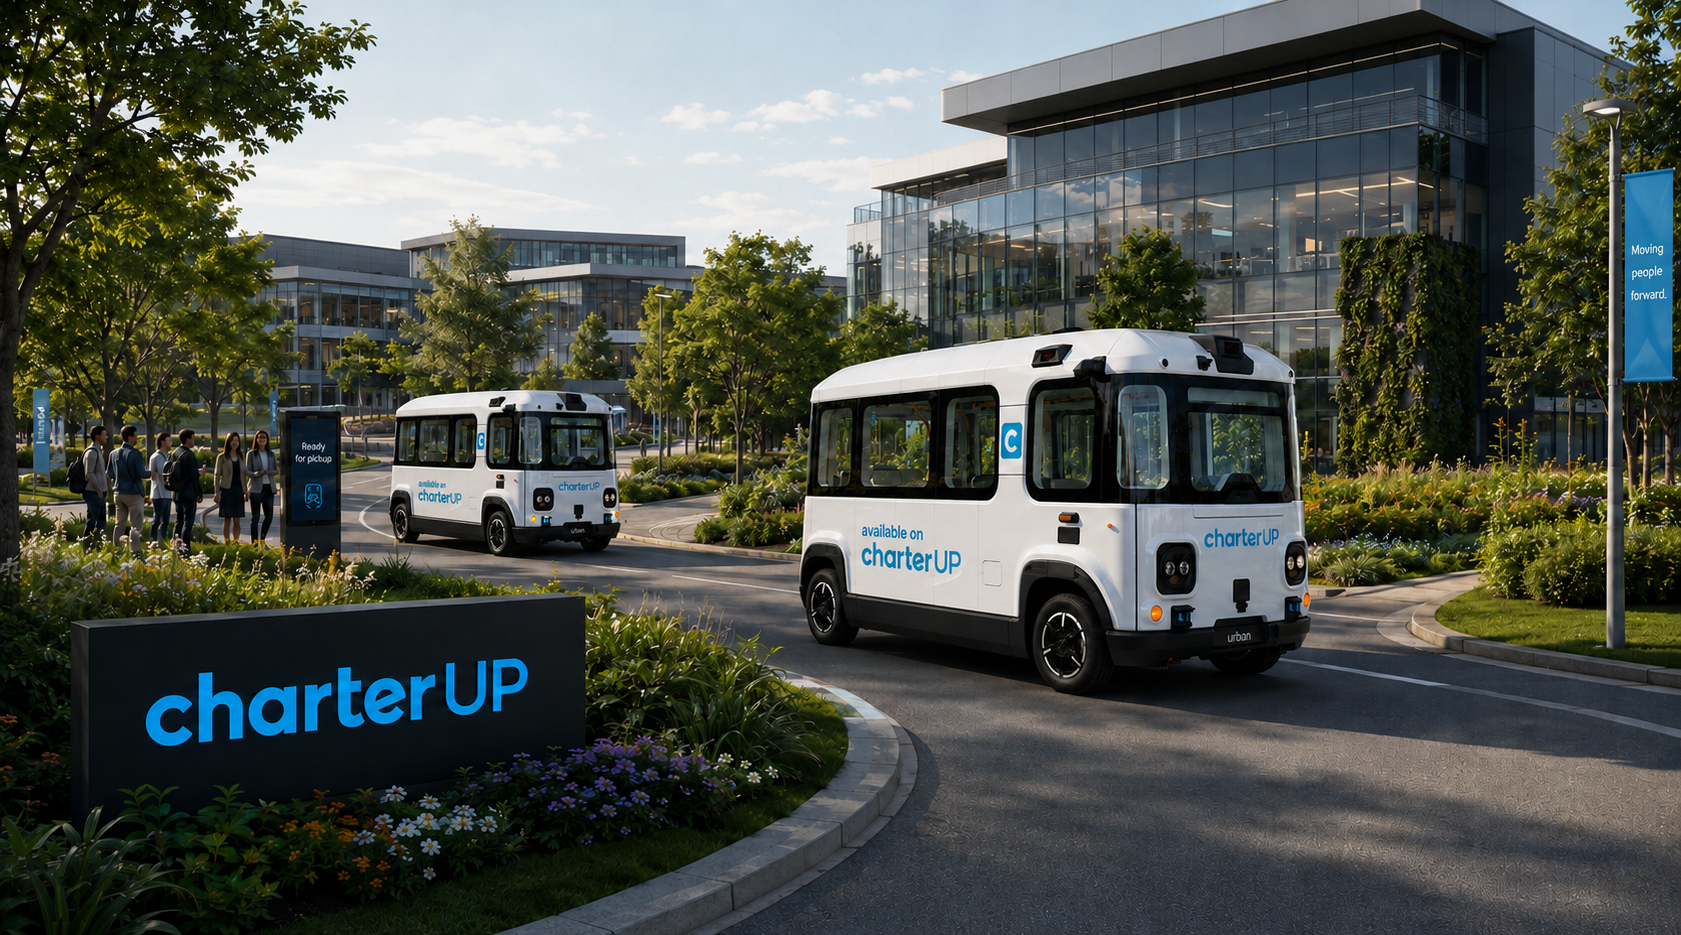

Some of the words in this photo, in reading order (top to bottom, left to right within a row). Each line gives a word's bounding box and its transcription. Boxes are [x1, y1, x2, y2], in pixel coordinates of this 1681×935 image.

[1631, 243, 1664, 256] Moving
[1631, 265, 1663, 280] people
[1630, 288, 1667, 301] forward.
[301, 441, 326, 453] Ready
[295, 454, 305, 464] for
[558, 481, 601, 492] charterUP
[417, 489, 463, 505] charterUP
[861, 523, 907, 541] available
[910, 529, 924, 541] on
[1203, 527, 1280, 549] charterUP
[861, 541, 962, 575] charterUP
[1227, 631, 1252, 643] urban
[145, 658, 530, 747] charterUP
